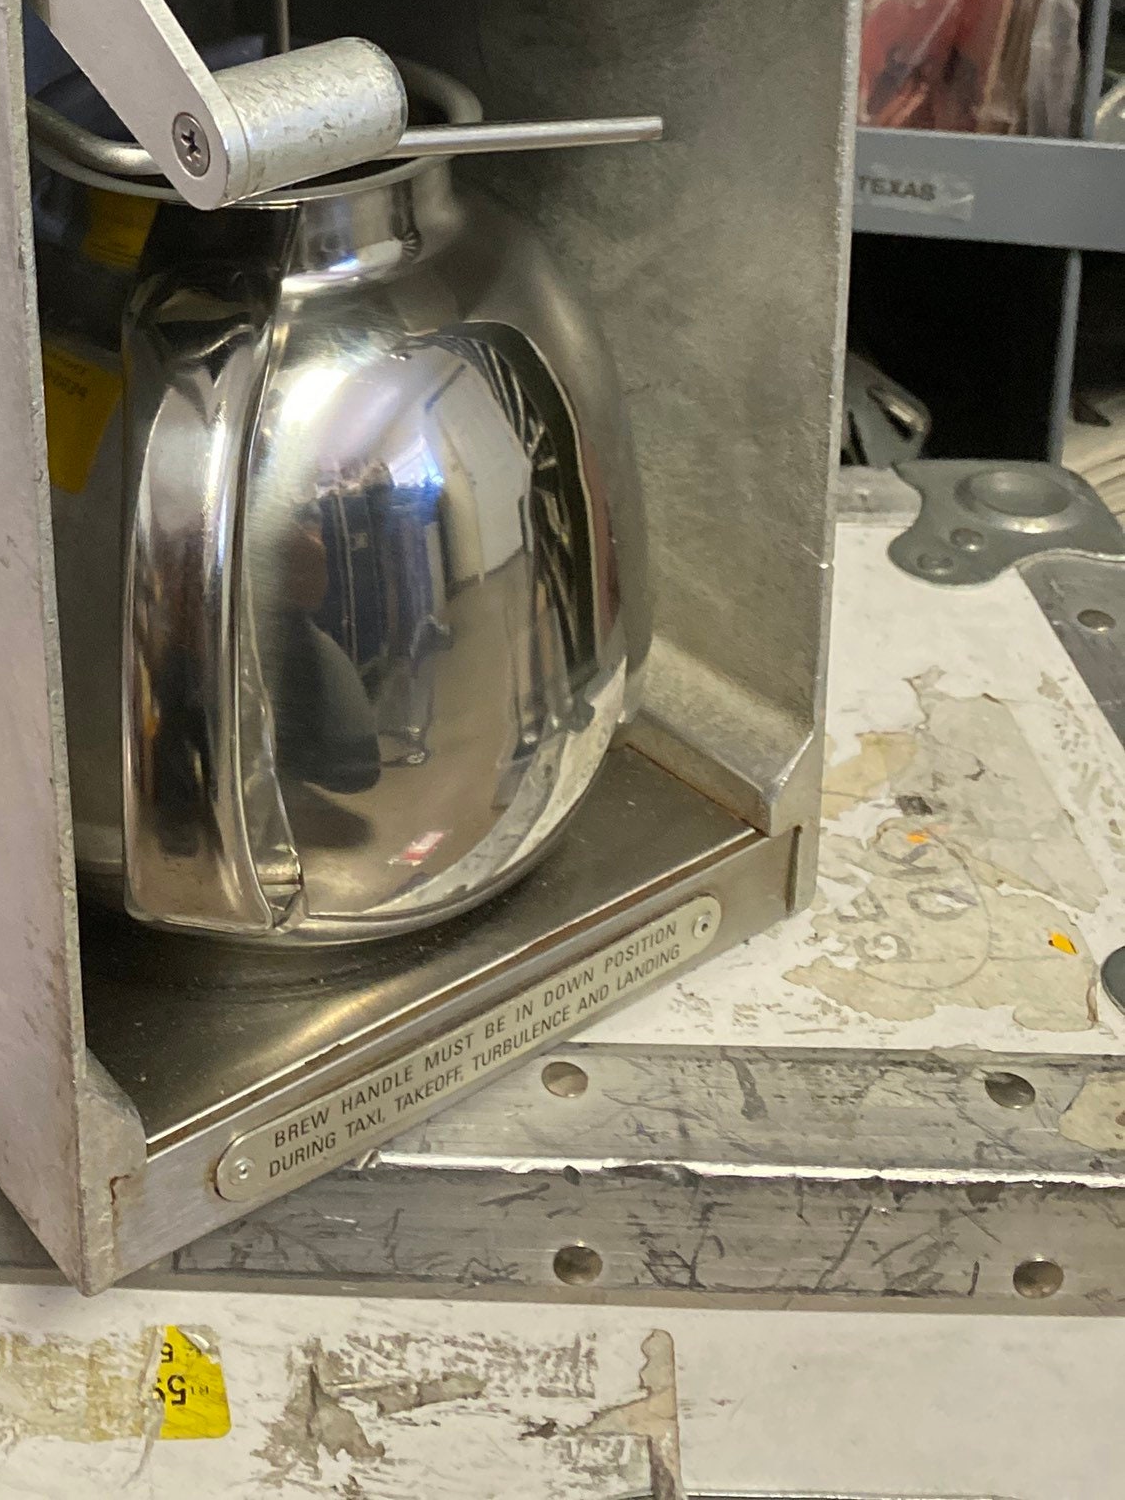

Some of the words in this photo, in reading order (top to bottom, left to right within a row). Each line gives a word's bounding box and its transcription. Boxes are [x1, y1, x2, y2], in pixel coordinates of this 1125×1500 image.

[268, 1131, 337, 1179] DURING
[472, 1004, 571, 1072] TURBULENCE
[577, 983, 610, 1014] AND
[617, 943, 681, 991] LANDING
[275, 1107, 330, 1149] BREW
[342, 1064, 414, 1115] HANDLE
[424, 1033, 475, 1073] MUST
[485, 1015, 506, 1040] BE
[516, 999, 534, 1023] IN
[544, 966, 595, 1007] DOWN
[604, 920, 679, 974] POSITION
